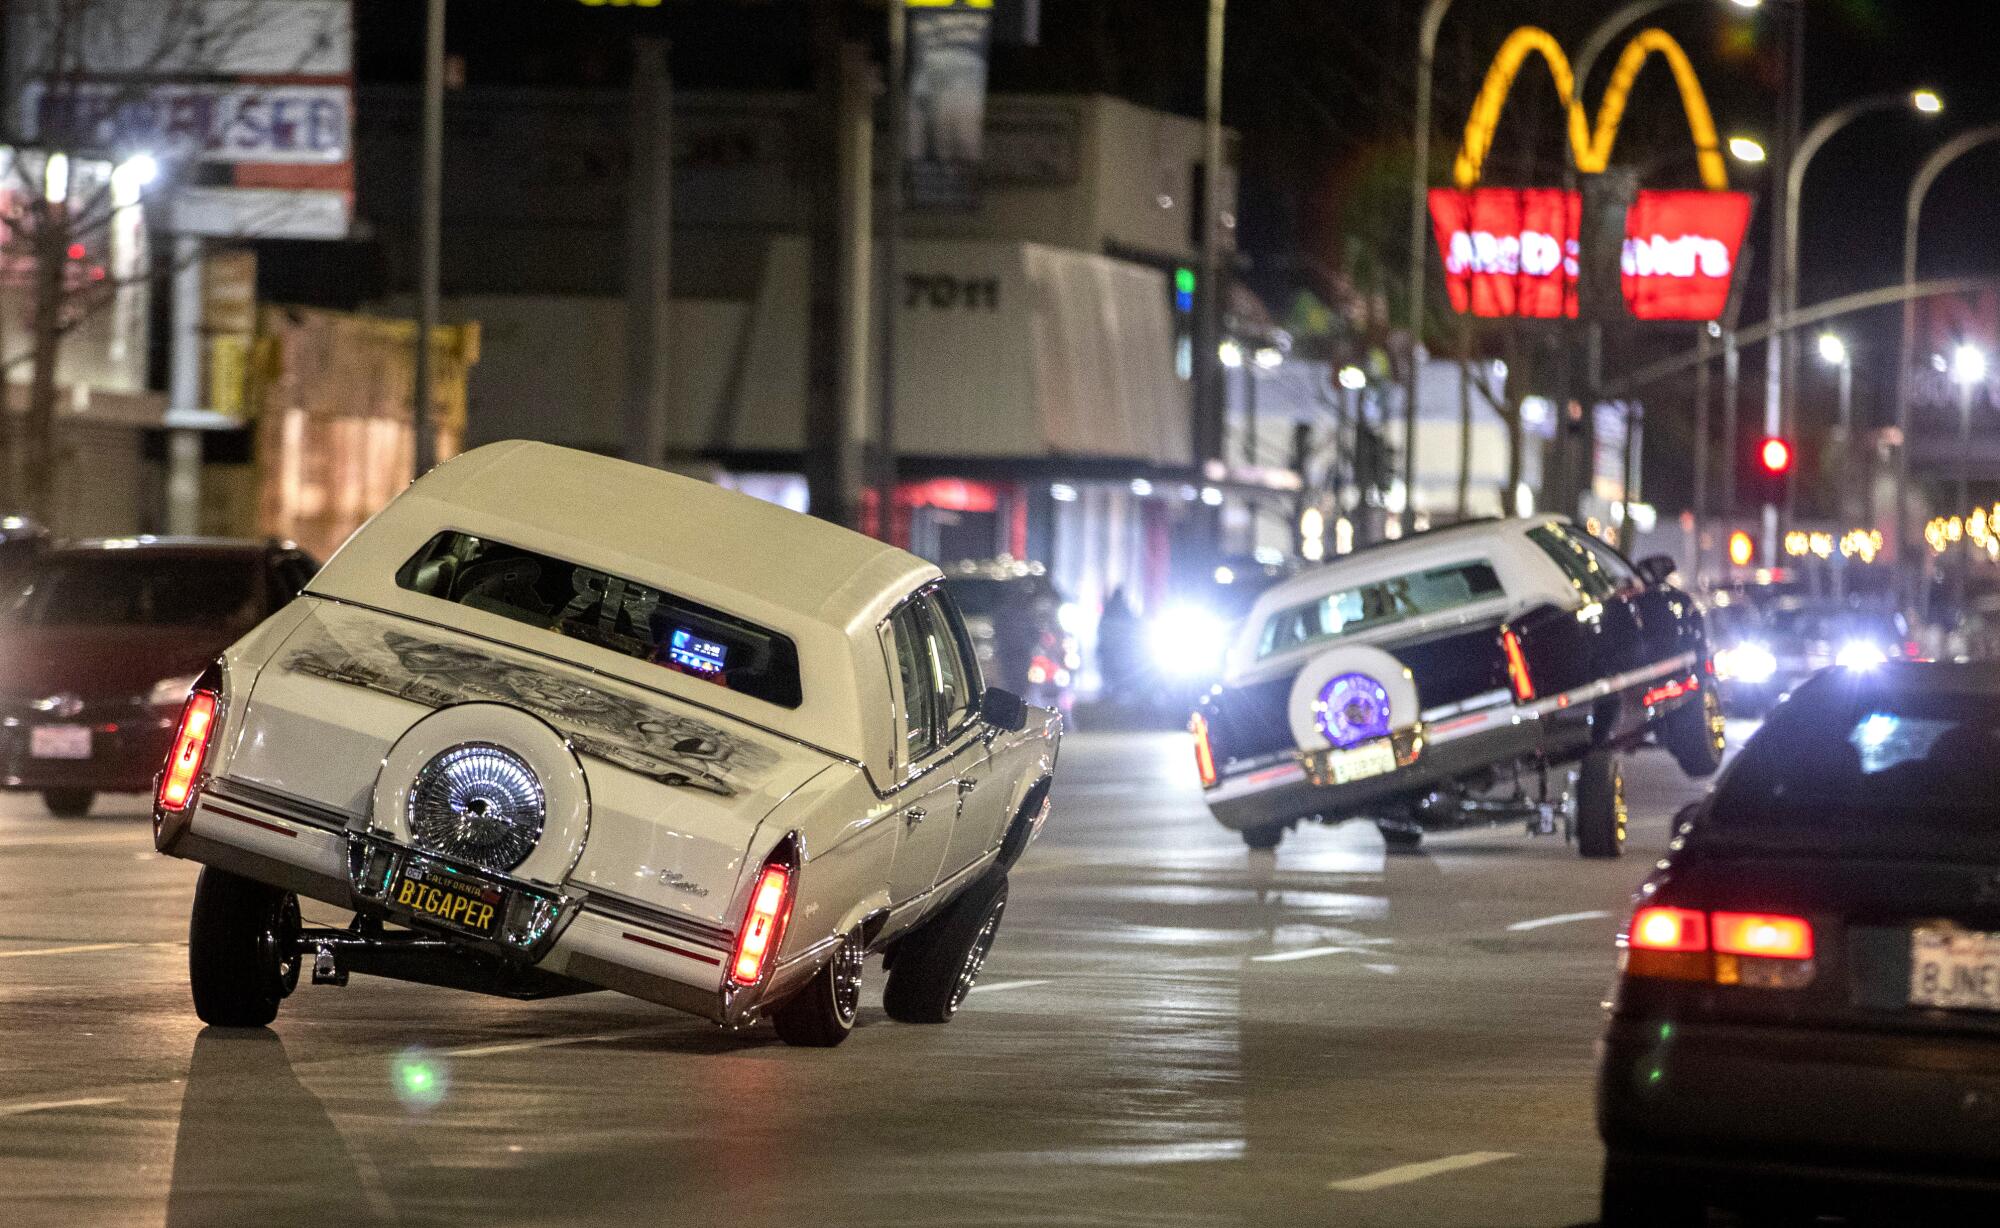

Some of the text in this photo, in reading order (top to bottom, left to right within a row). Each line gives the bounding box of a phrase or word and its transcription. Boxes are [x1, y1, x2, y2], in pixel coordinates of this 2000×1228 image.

[903, 272, 999, 311] 7011
[426, 873, 481, 896] CALIFORNIA
[398, 880, 494, 929] BIGAPER
